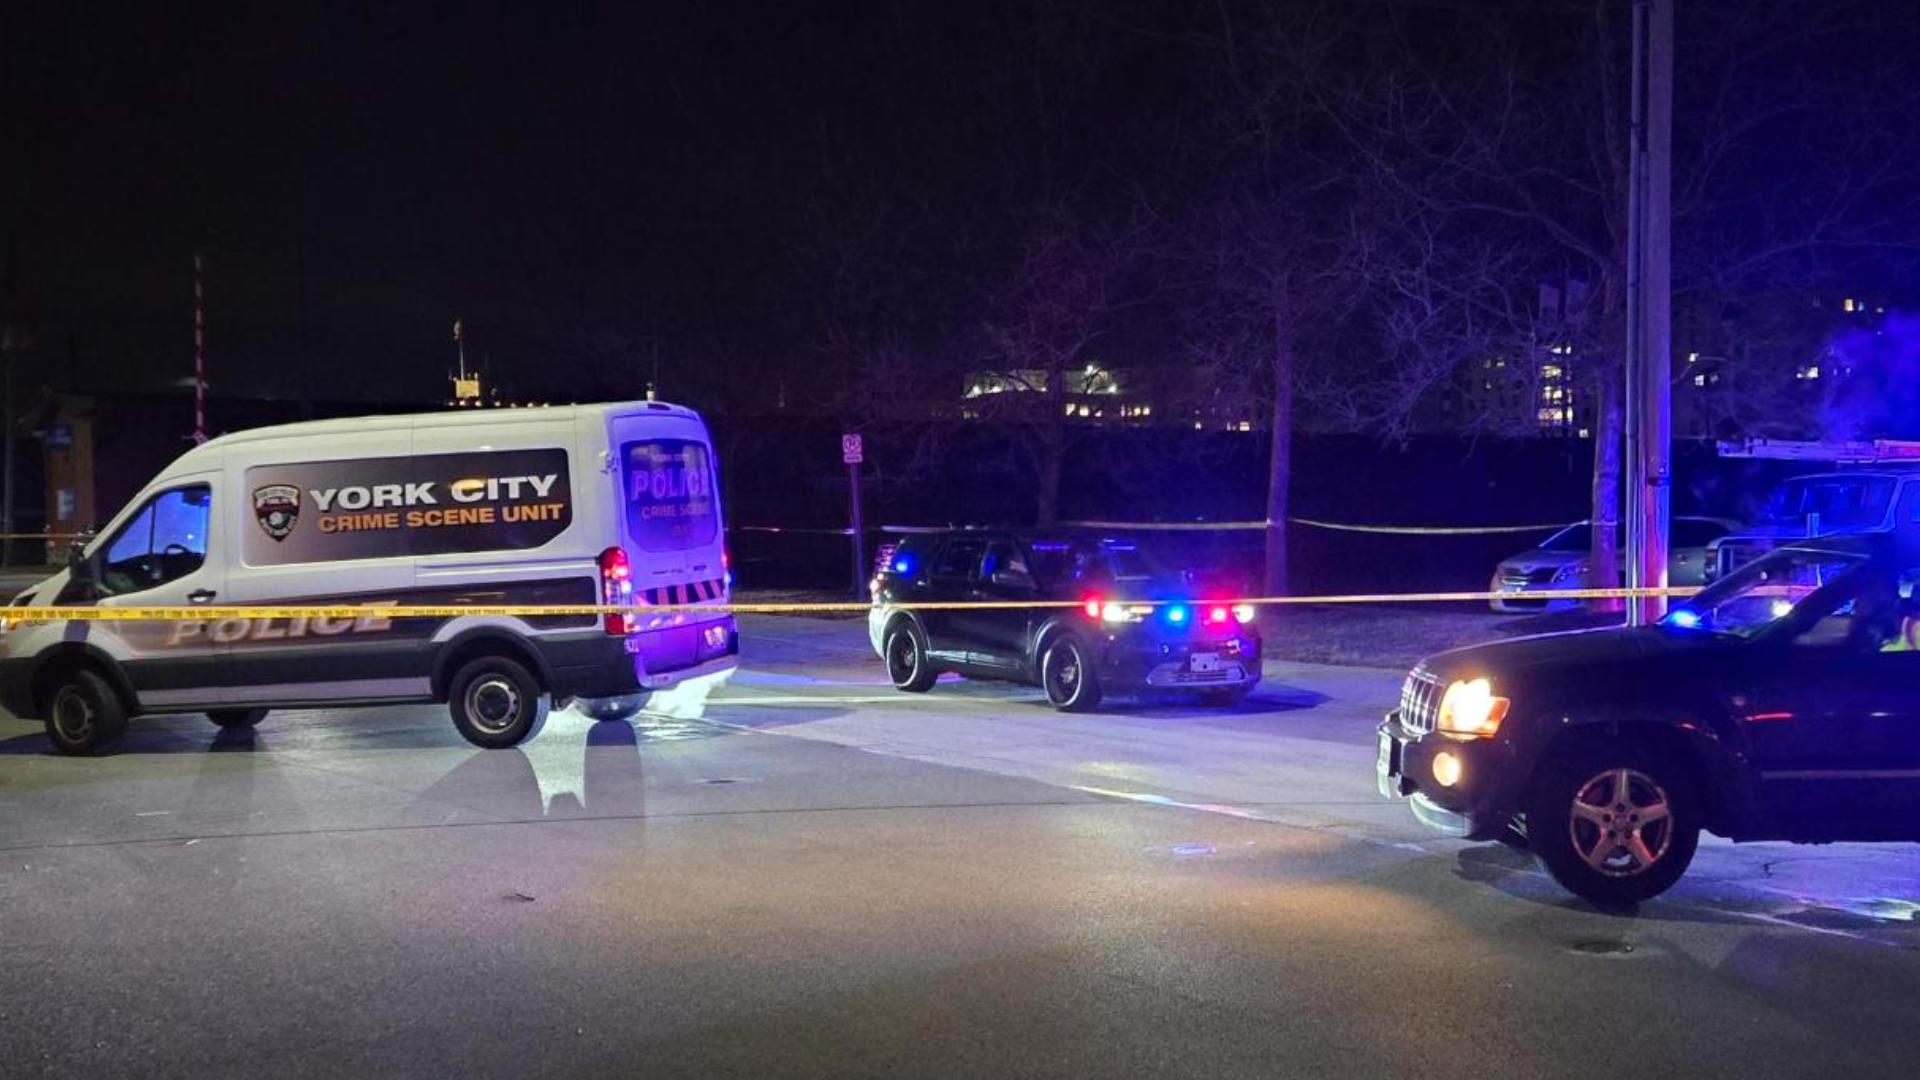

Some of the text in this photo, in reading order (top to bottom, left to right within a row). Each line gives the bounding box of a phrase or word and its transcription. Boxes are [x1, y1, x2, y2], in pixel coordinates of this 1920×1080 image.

[310, 473, 558, 511] YORK CITY
[319, 513, 399, 533] CRIME
[406, 508, 496, 527] SCENE
[502, 504, 564, 523] UNIT
[166, 600, 398, 646] POLICE
